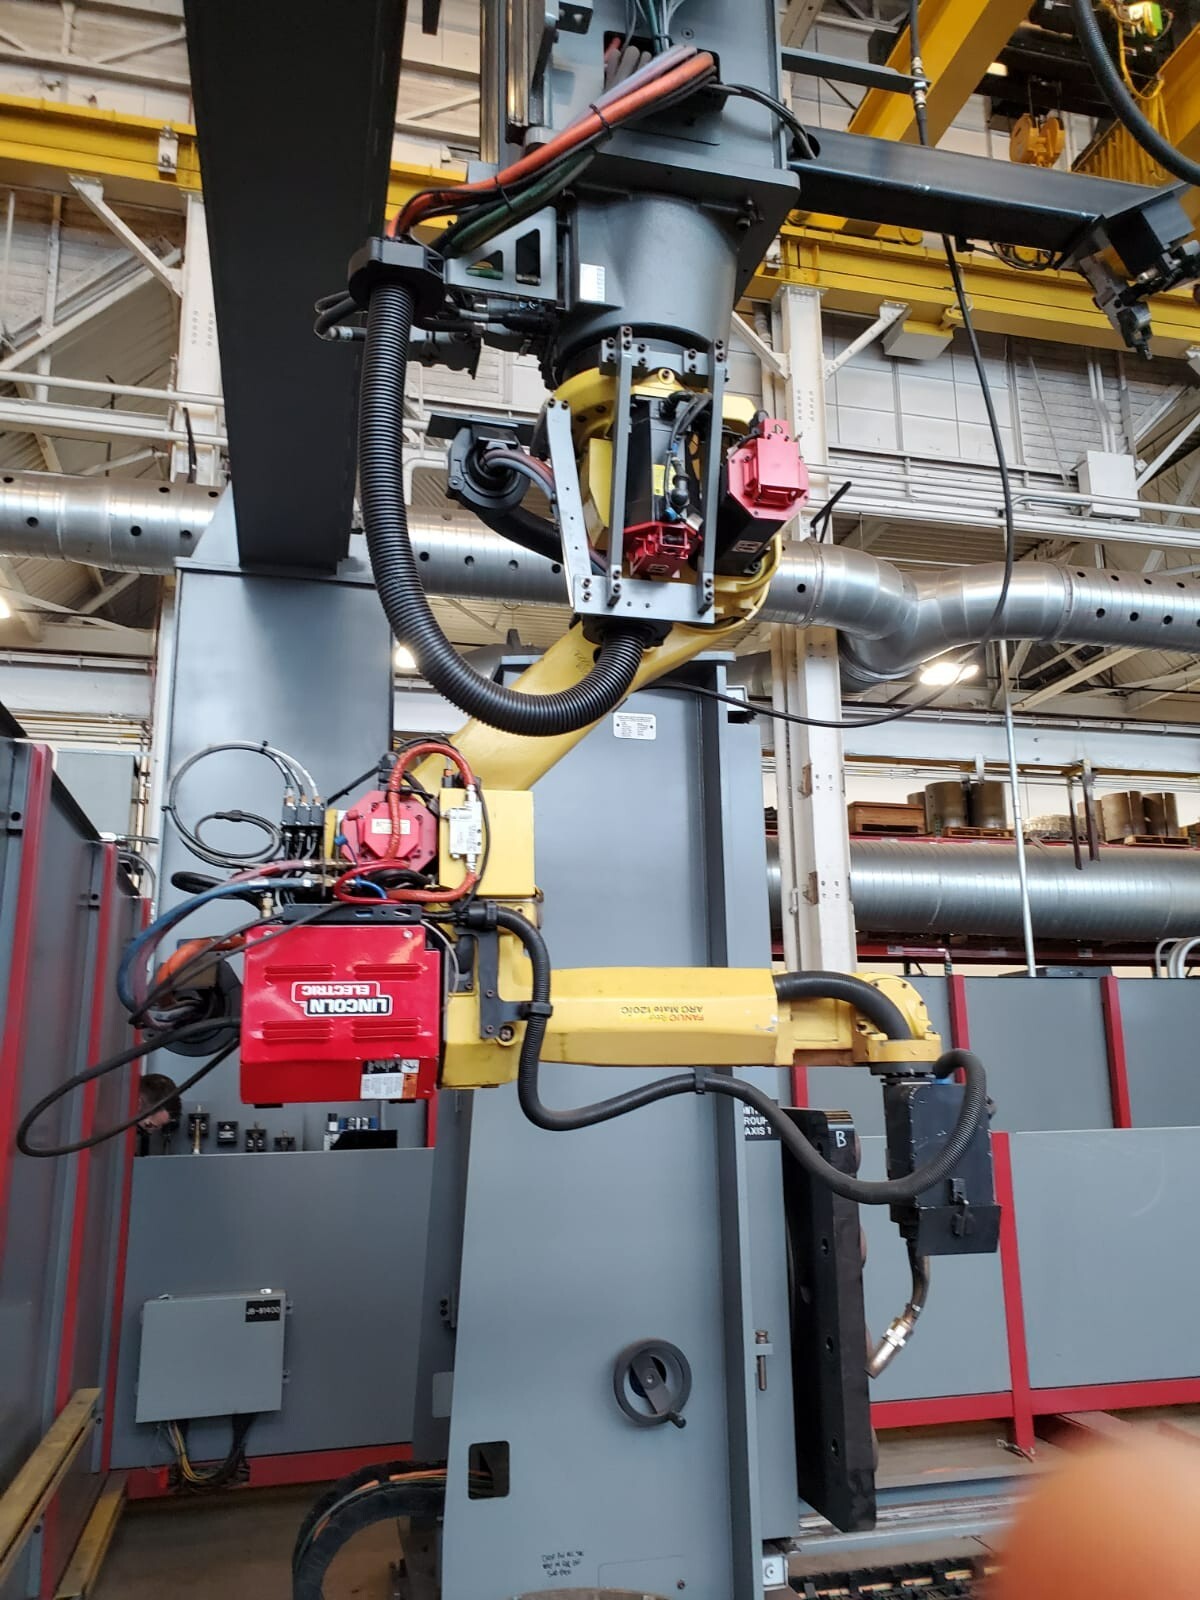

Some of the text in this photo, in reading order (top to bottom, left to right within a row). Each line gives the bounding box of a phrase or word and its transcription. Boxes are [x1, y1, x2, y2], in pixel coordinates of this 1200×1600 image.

[301, 984, 370, 996] ELECTRIC
[309, 998, 388, 1013] LINCOLN
[680, 1005, 703, 1014] ARC
[668, 1014, 704, 1022] FANUC
[744, 1126, 766, 1136] AXIS
[835, 1130, 847, 1148] B
